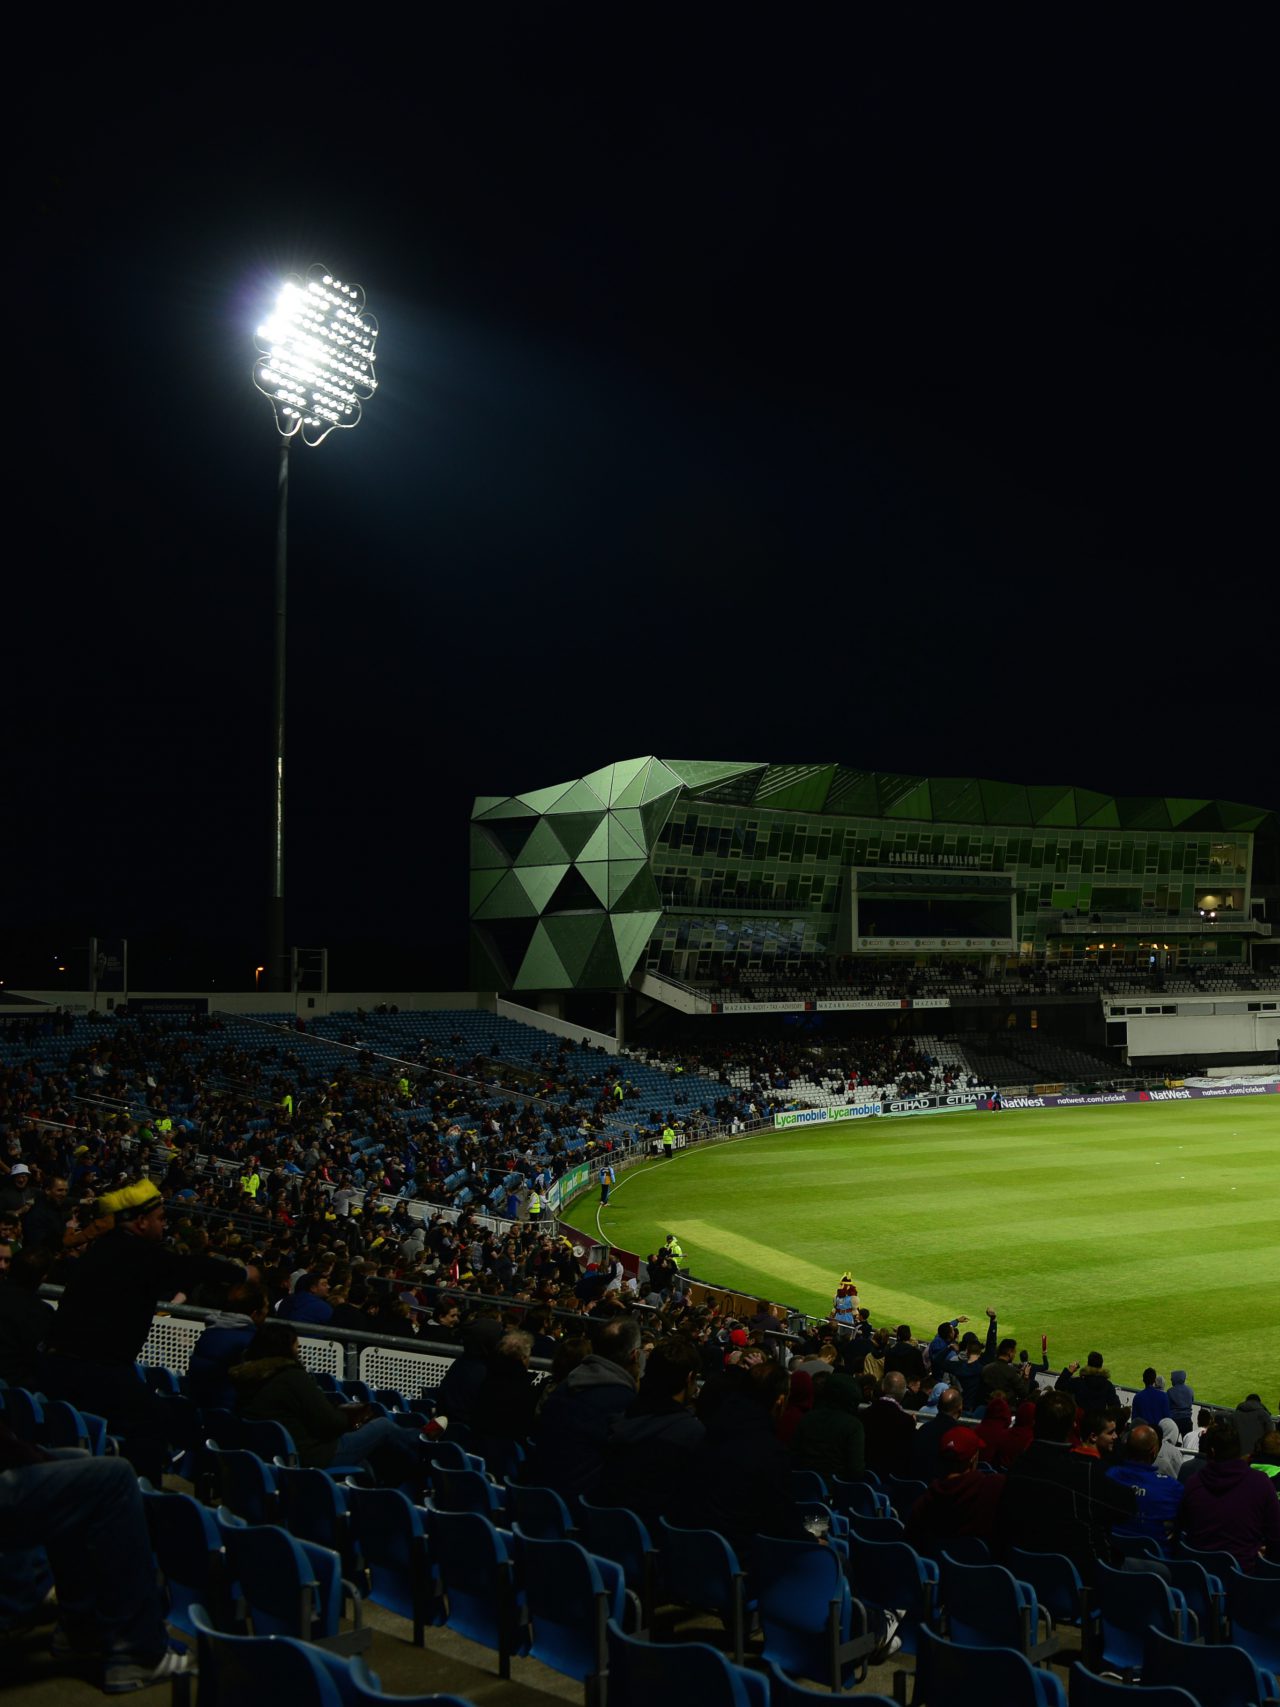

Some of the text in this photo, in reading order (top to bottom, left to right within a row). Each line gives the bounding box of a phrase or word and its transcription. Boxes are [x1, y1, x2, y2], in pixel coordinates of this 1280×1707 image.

[888, 852, 979, 865] CARNEGIE PAVILION
[1149, 1090, 1192, 1100] NatWest
[1202, 1086, 1266, 1096] natwest.com/cricket
[946, 1093, 987, 1105] ETIHAD
[1000, 1097, 1045, 1109] NatWest
[1057, 1094, 1127, 1104] natwest.com/cricket
[828, 1102, 881, 1120] Lycamobile
[890, 1099, 929, 1112] ETIHAD
[776, 1108, 827, 1127] Lycamobile
